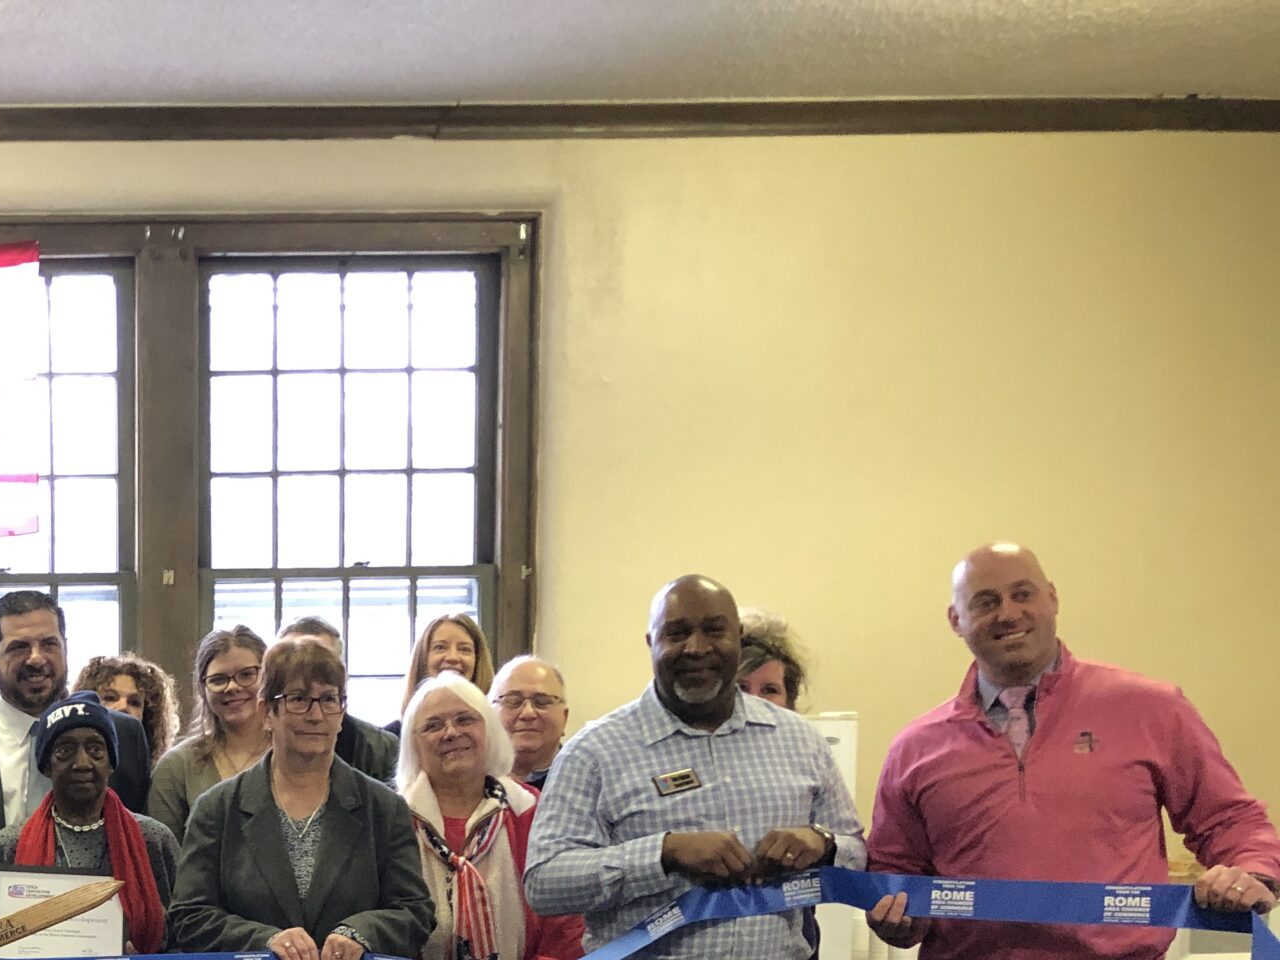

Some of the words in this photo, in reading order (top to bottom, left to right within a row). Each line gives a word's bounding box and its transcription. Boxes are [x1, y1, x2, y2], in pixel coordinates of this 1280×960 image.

[46, 703, 86, 728] NAVY
[783, 878, 821, 891] ROME
[931, 890, 974, 901] ROME
[1104, 896, 1151, 907] ROME
